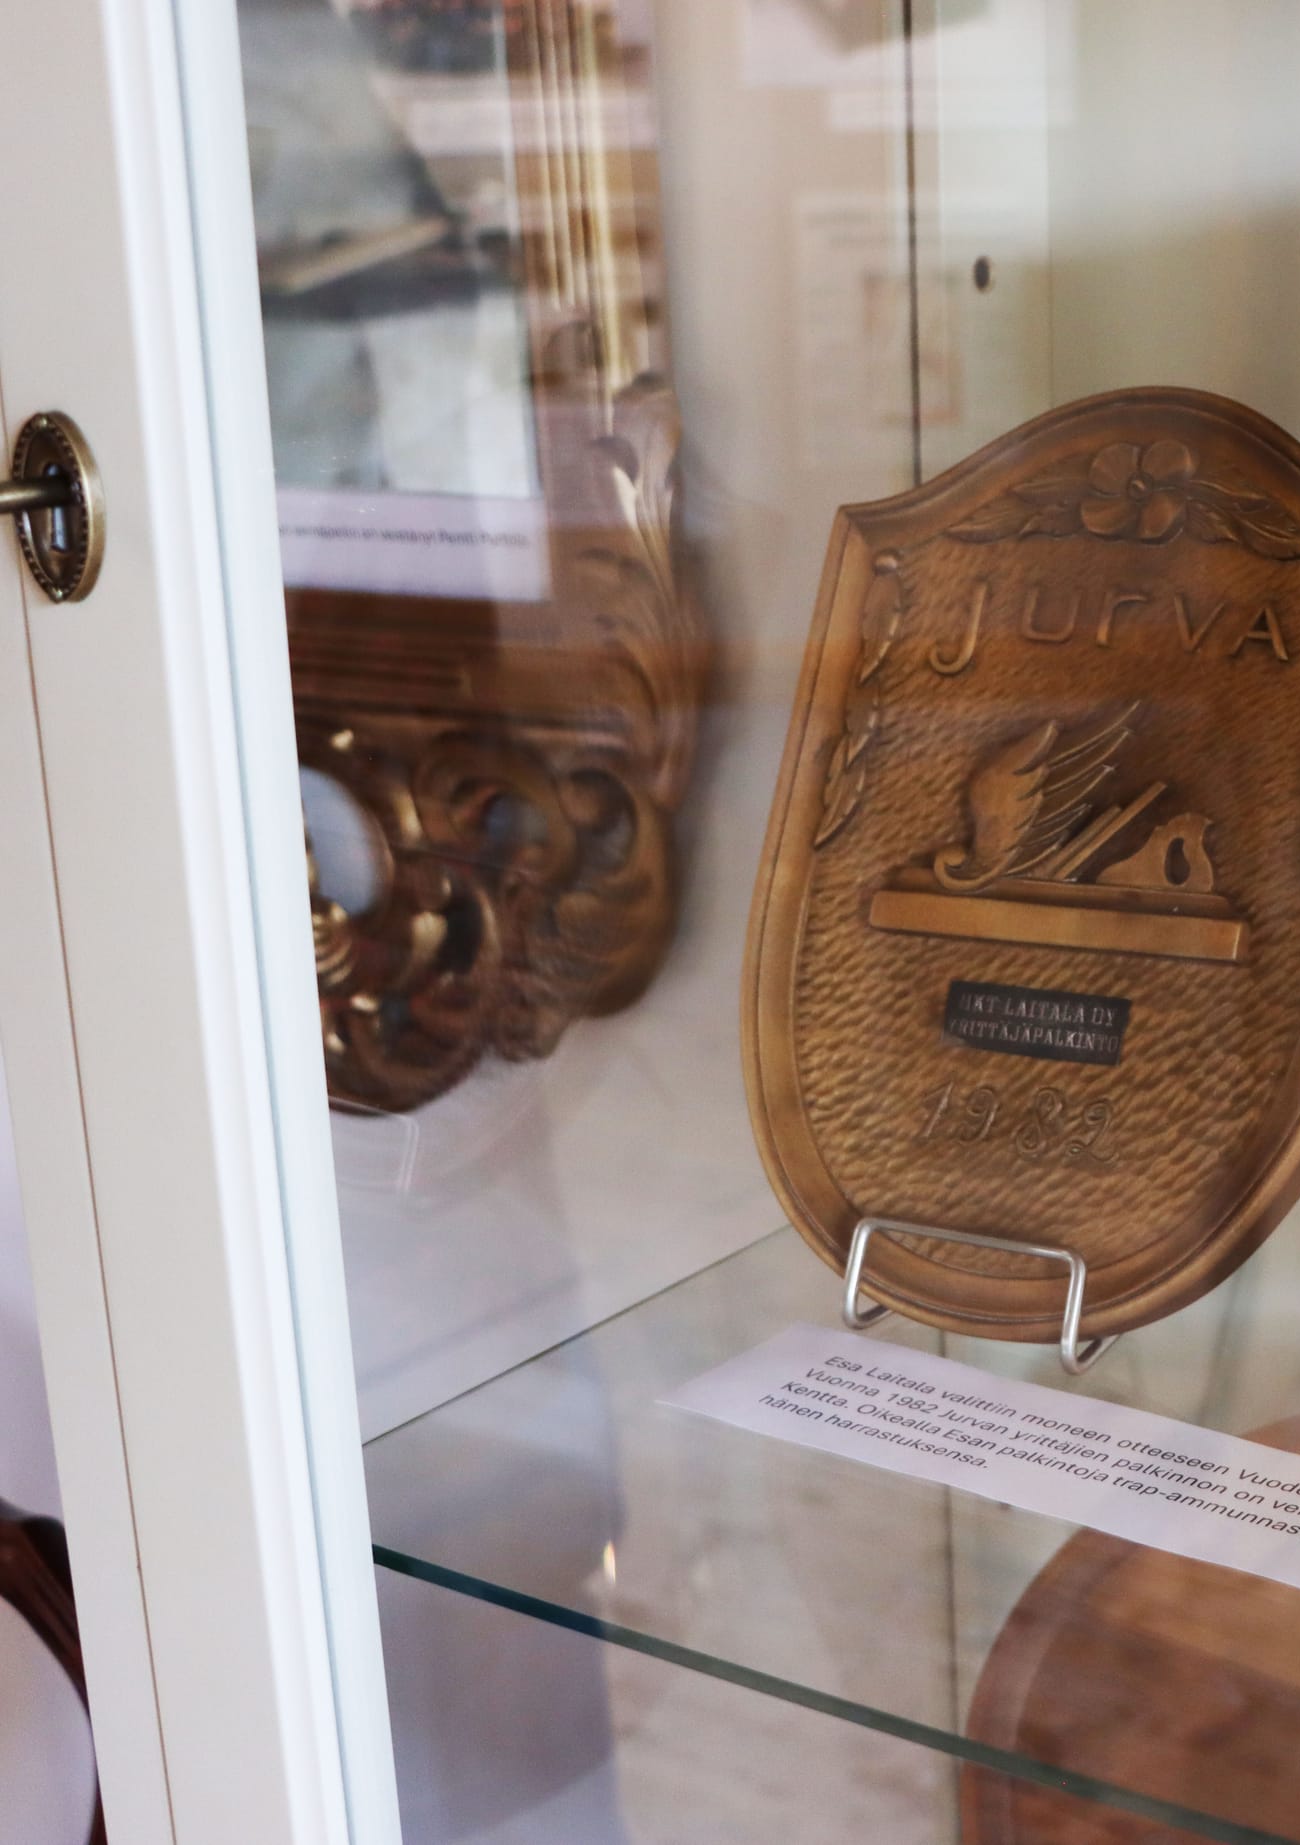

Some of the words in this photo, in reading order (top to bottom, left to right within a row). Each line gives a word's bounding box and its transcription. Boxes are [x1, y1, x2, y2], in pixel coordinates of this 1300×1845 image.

[1004, 998, 1084, 1023] LAITALA
[1092, 1006, 1116, 1027] OY
[912, 1080, 1120, 1163] 1982
[758, 1394, 824, 1421] hänen
[824, 1414, 988, 1469] harrastuksensa.
[806, 1368, 880, 1398] Vuonna
[887, 1393, 939, 1414] 1982
[938, 1409, 1009, 1435] Jurvan
[1009, 1430, 1110, 1463] yrittäjien
[1111, 1458, 1228, 1495] palkinnon
[1234, 1490, 1265, 1505] on
[825, 1356, 863, 1373] Esa
[866, 1367, 936, 1395] Laitala
[941, 1389, 1017, 1418] valittiin
[1020, 1414, 1111, 1443] moneen
[1117, 1439, 1230, 1475] otteeseen
[857, 1403, 942, 1435] Oikealla
[943, 1428, 997, 1450] Esan
[996, 1446, 1110, 1482] palkintoja
